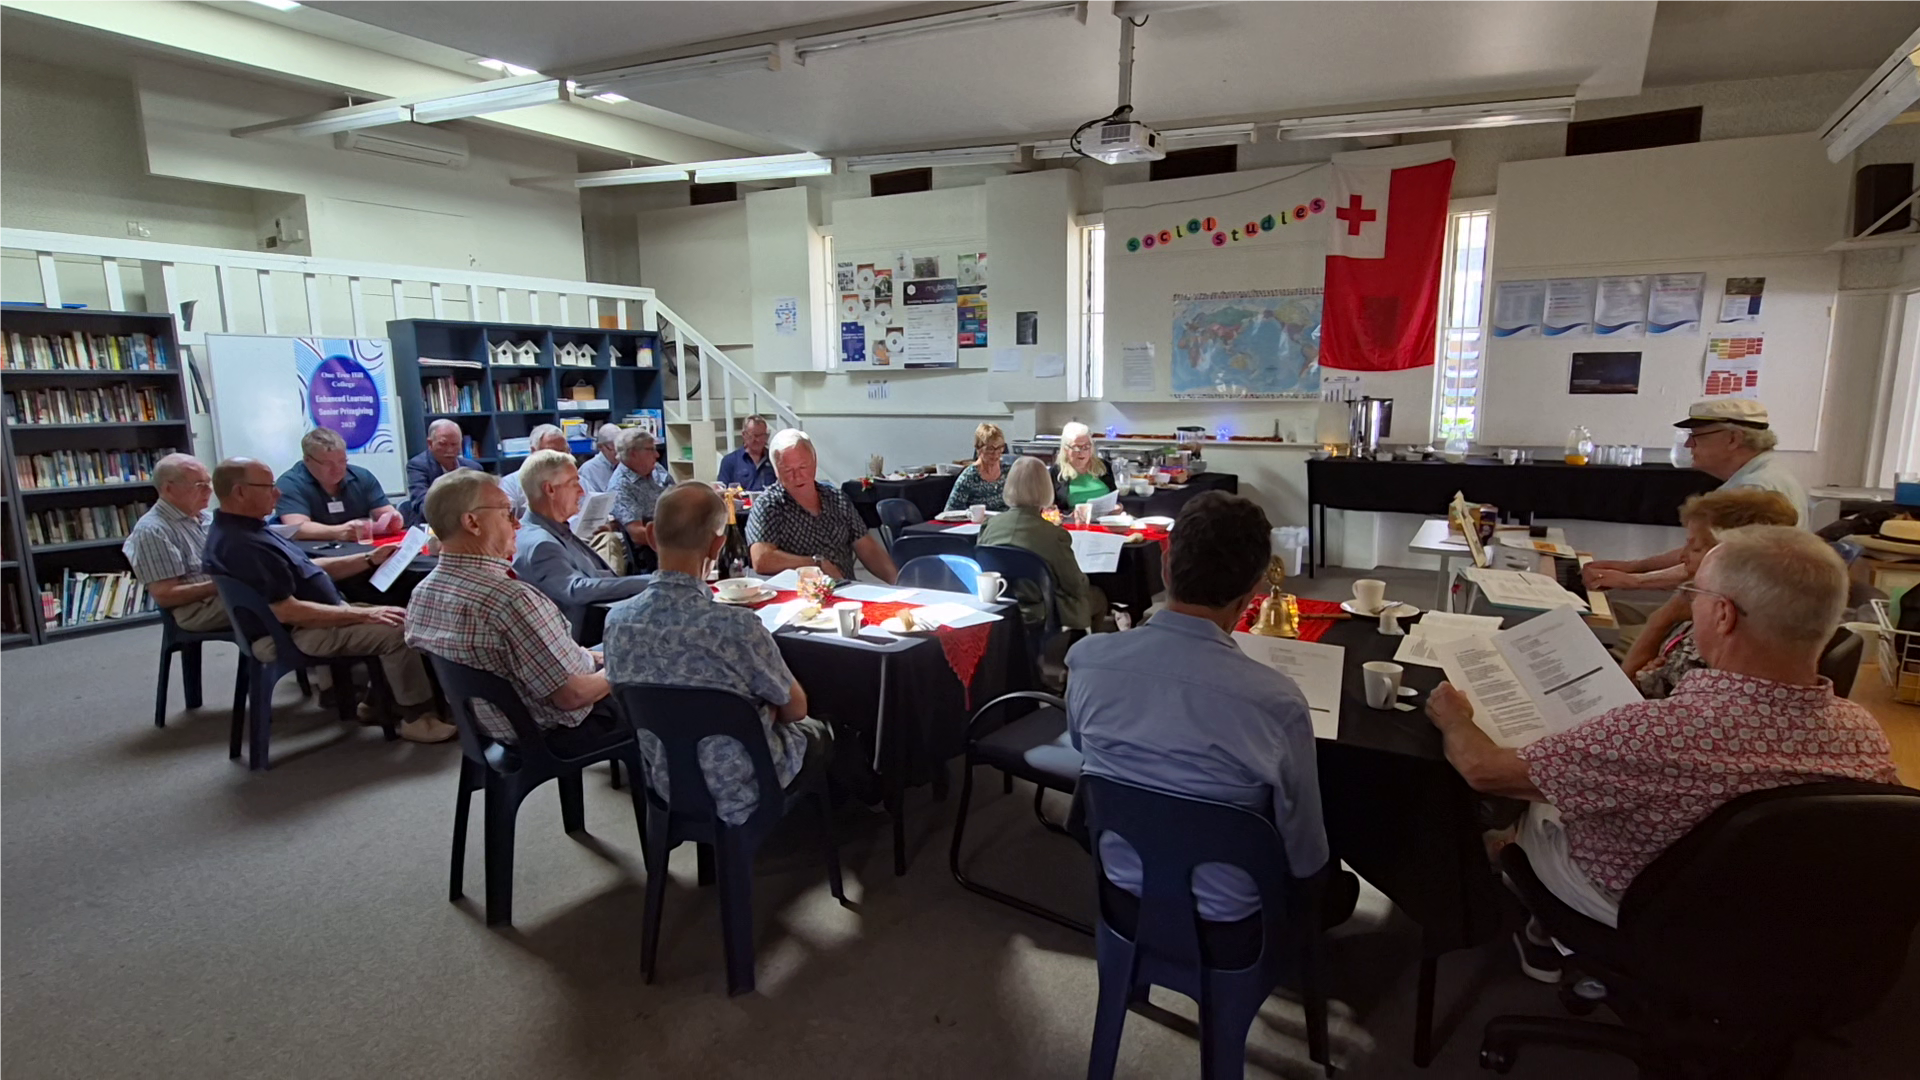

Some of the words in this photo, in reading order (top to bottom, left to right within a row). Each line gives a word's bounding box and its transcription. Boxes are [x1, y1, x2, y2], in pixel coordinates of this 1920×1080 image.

[1213, 199, 1323, 246] studies
[1128, 217, 1213, 252] social
[331, 380, 356, 388] College
[315, 394, 346, 403] Enhanced
[346, 394, 374, 404] Learning
[318, 408, 339, 416] Senior
[339, 407, 374, 416] Prizegiving
